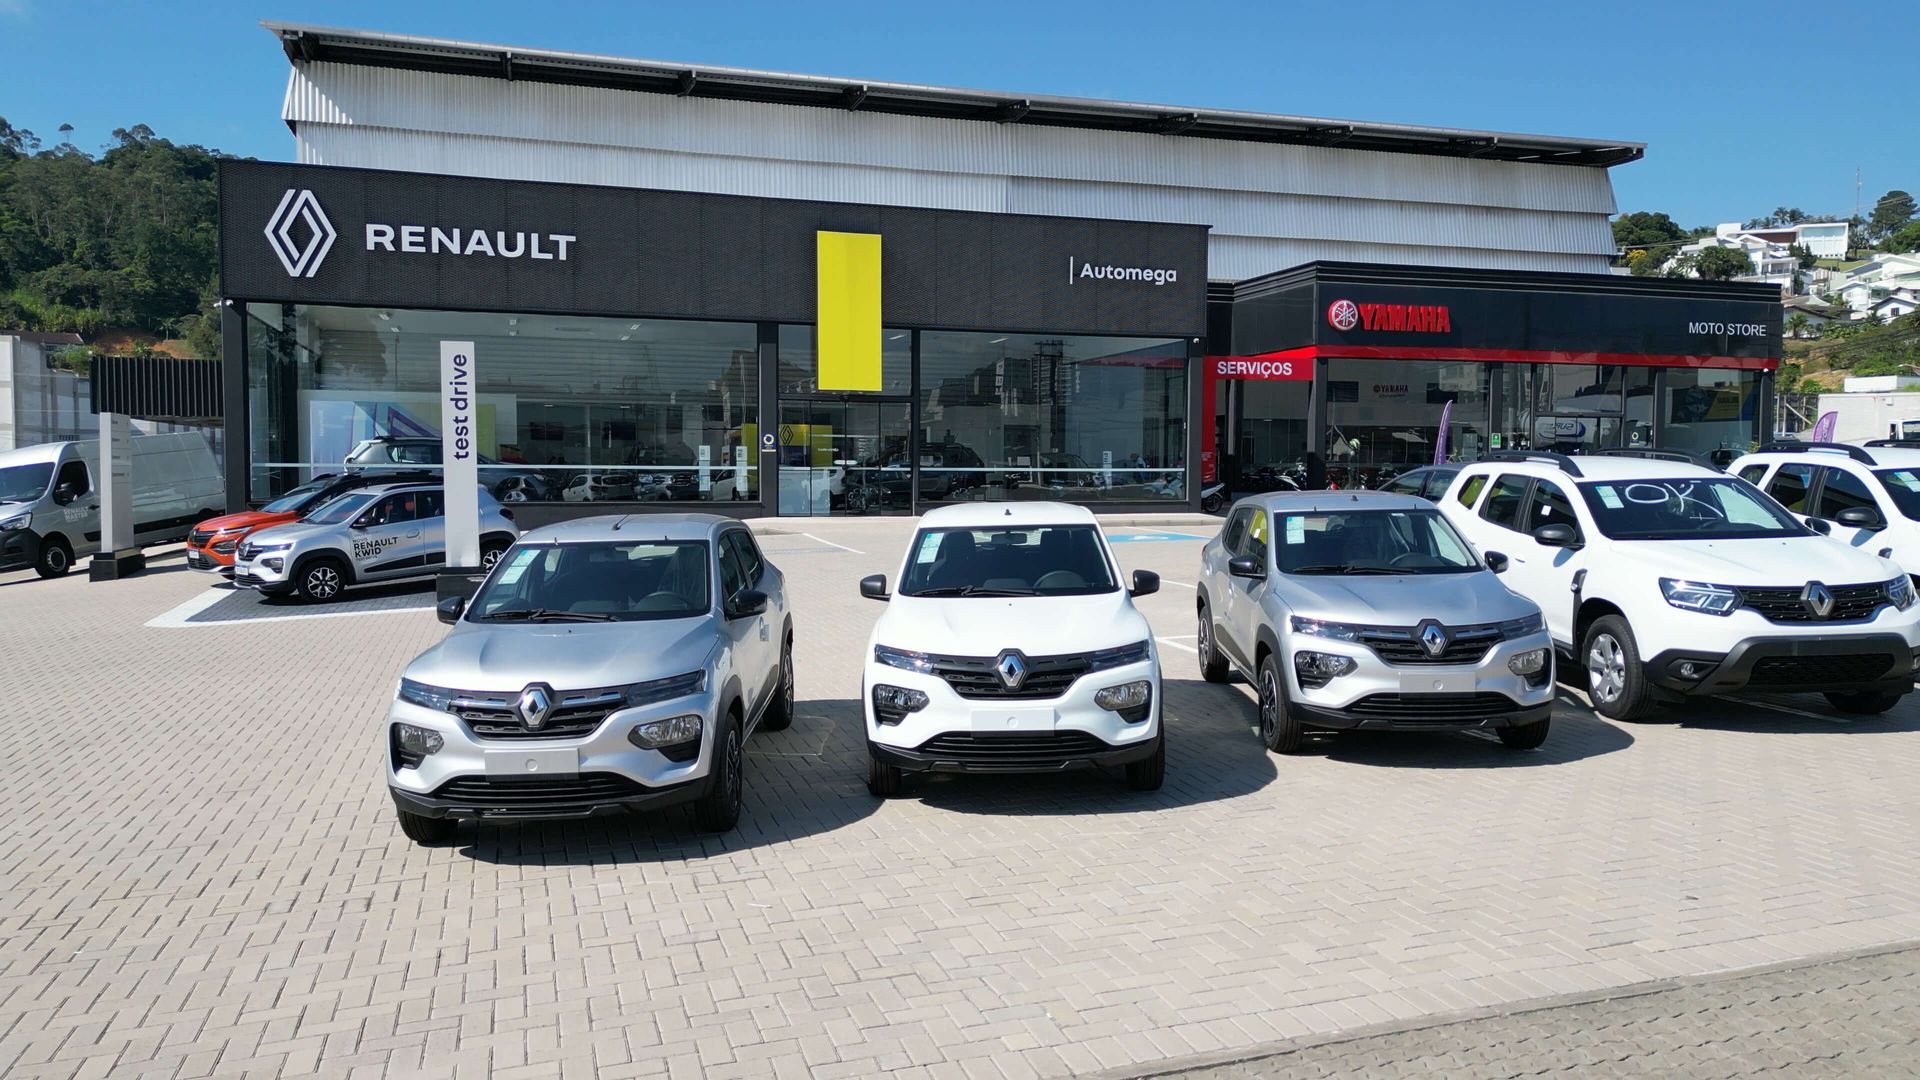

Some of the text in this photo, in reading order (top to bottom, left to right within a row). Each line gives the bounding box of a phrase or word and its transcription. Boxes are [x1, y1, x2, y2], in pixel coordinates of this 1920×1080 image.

[366, 223, 577, 261] RENAULT
[1080, 263, 1177, 286] Automega
[1358, 303, 1451, 333] YAMAHA
[1688, 321, 1767, 337] MOTO STORE
[1216, 361, 1293, 379] SERVIÇOS
[449, 354, 469, 460] test drive
[353, 536, 399, 550] RENAULT
[355, 547, 382, 558] KWID
